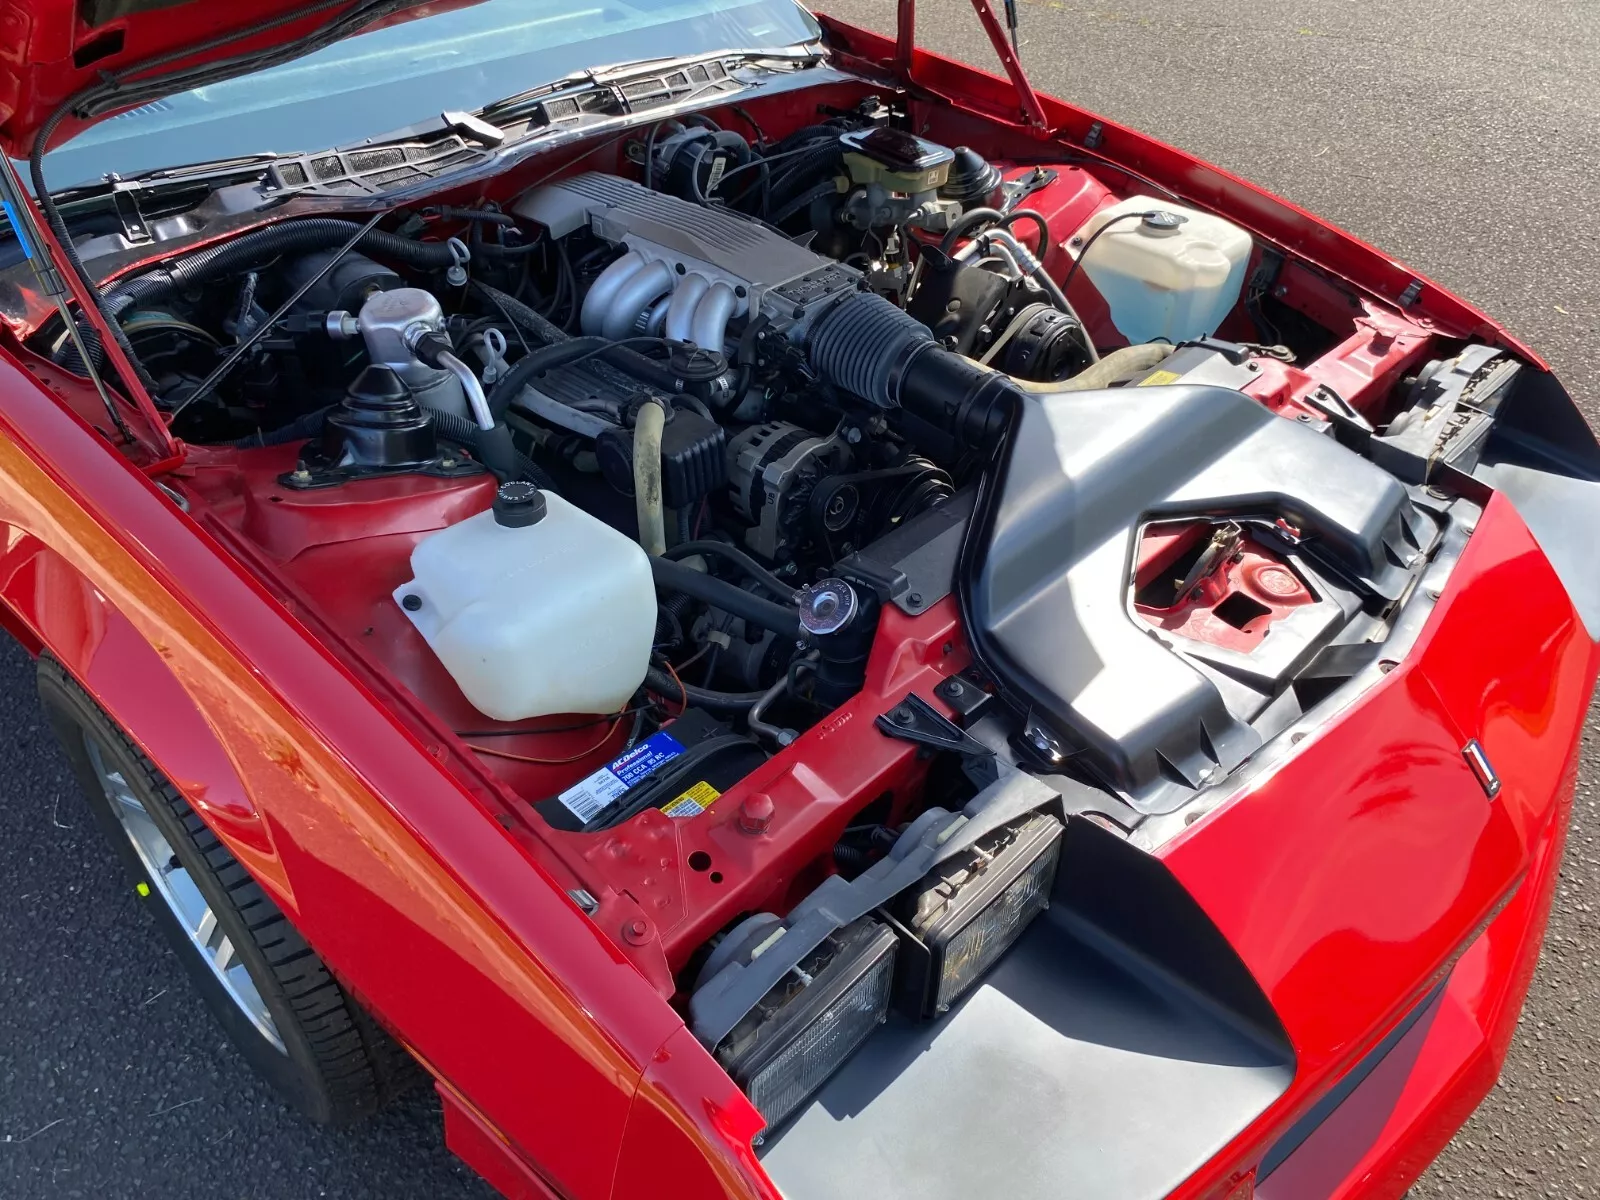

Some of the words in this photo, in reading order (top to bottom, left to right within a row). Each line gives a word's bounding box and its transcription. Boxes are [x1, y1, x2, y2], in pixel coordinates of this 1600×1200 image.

[612, 743, 650, 770] ACDelco
[616, 750, 653, 776] Professional
[621, 771, 635, 782] 700
[632, 763, 648, 775] CCA
[654, 751, 666, 761] RC
